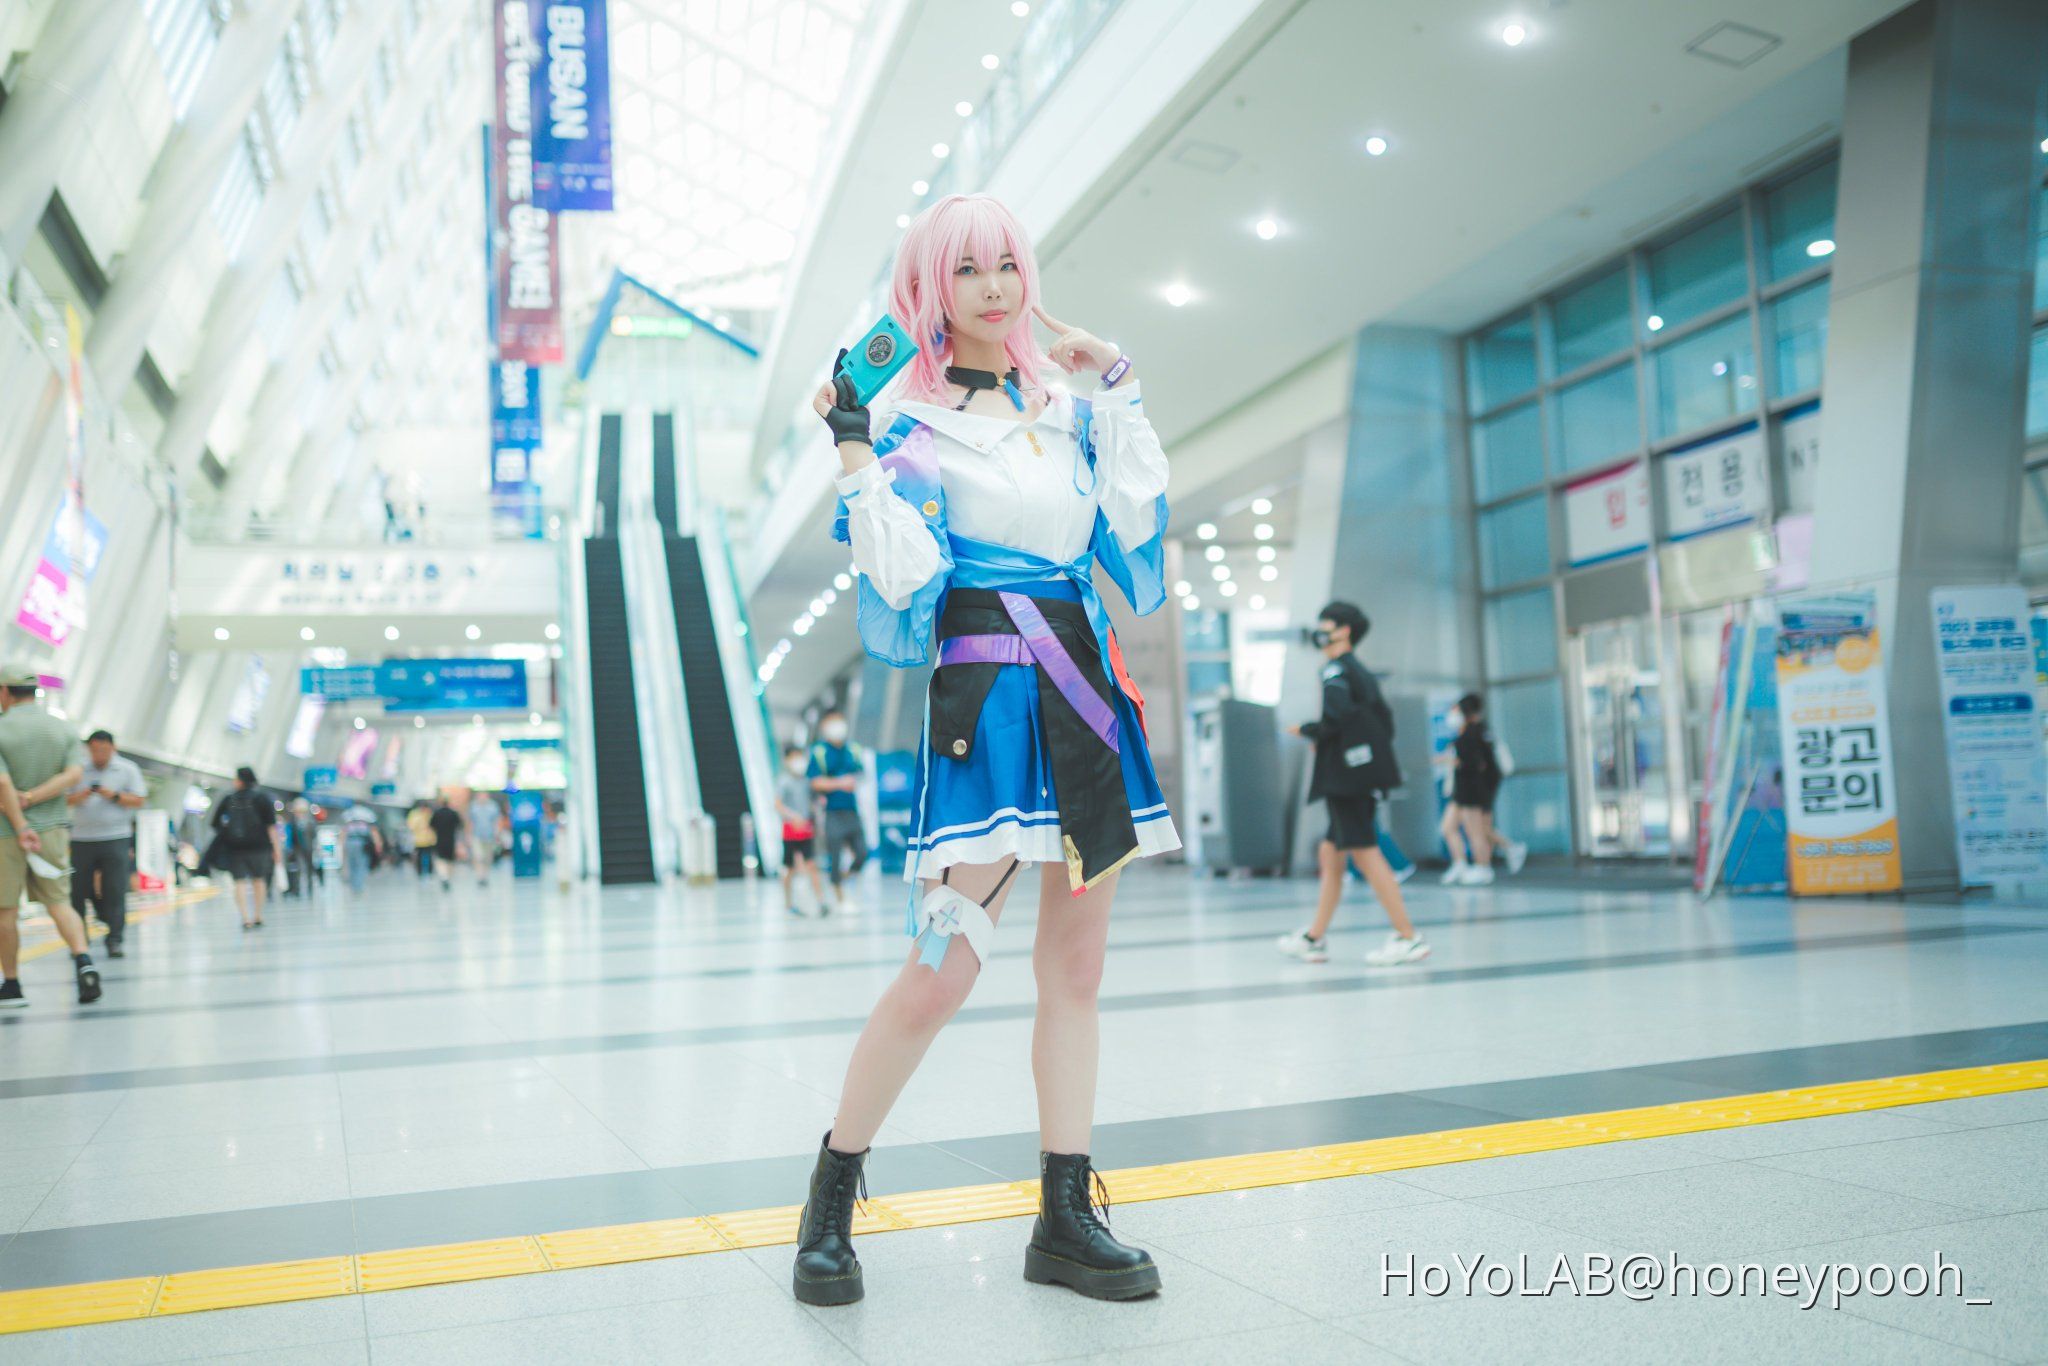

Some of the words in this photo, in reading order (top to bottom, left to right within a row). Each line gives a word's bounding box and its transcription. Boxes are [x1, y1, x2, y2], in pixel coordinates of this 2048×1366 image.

[546, 5, 588, 139] BUSAN
[1796, 727, 1880, 767] 광고
[1801, 772, 1882, 813] 문의
